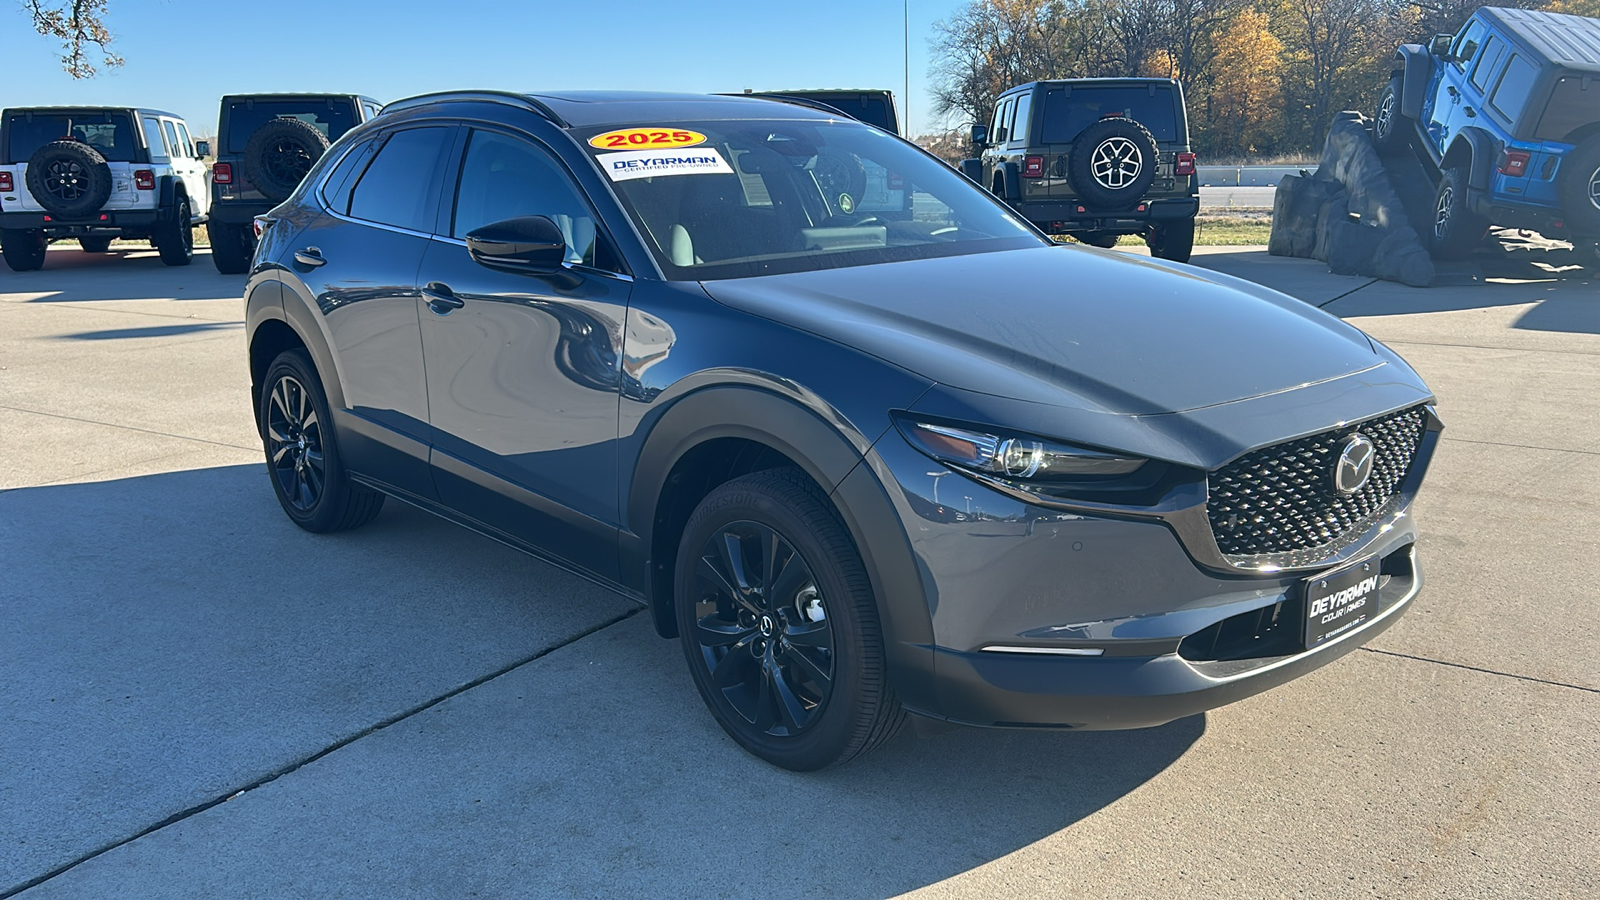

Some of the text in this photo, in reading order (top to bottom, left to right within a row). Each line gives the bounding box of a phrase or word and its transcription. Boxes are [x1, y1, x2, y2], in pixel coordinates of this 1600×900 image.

[606, 132, 692, 147] 2025
[614, 157, 716, 170] DEYARMAN
[624, 165, 669, 173] CERTIFIED
[1310, 575, 1378, 618] DEYARMAN
